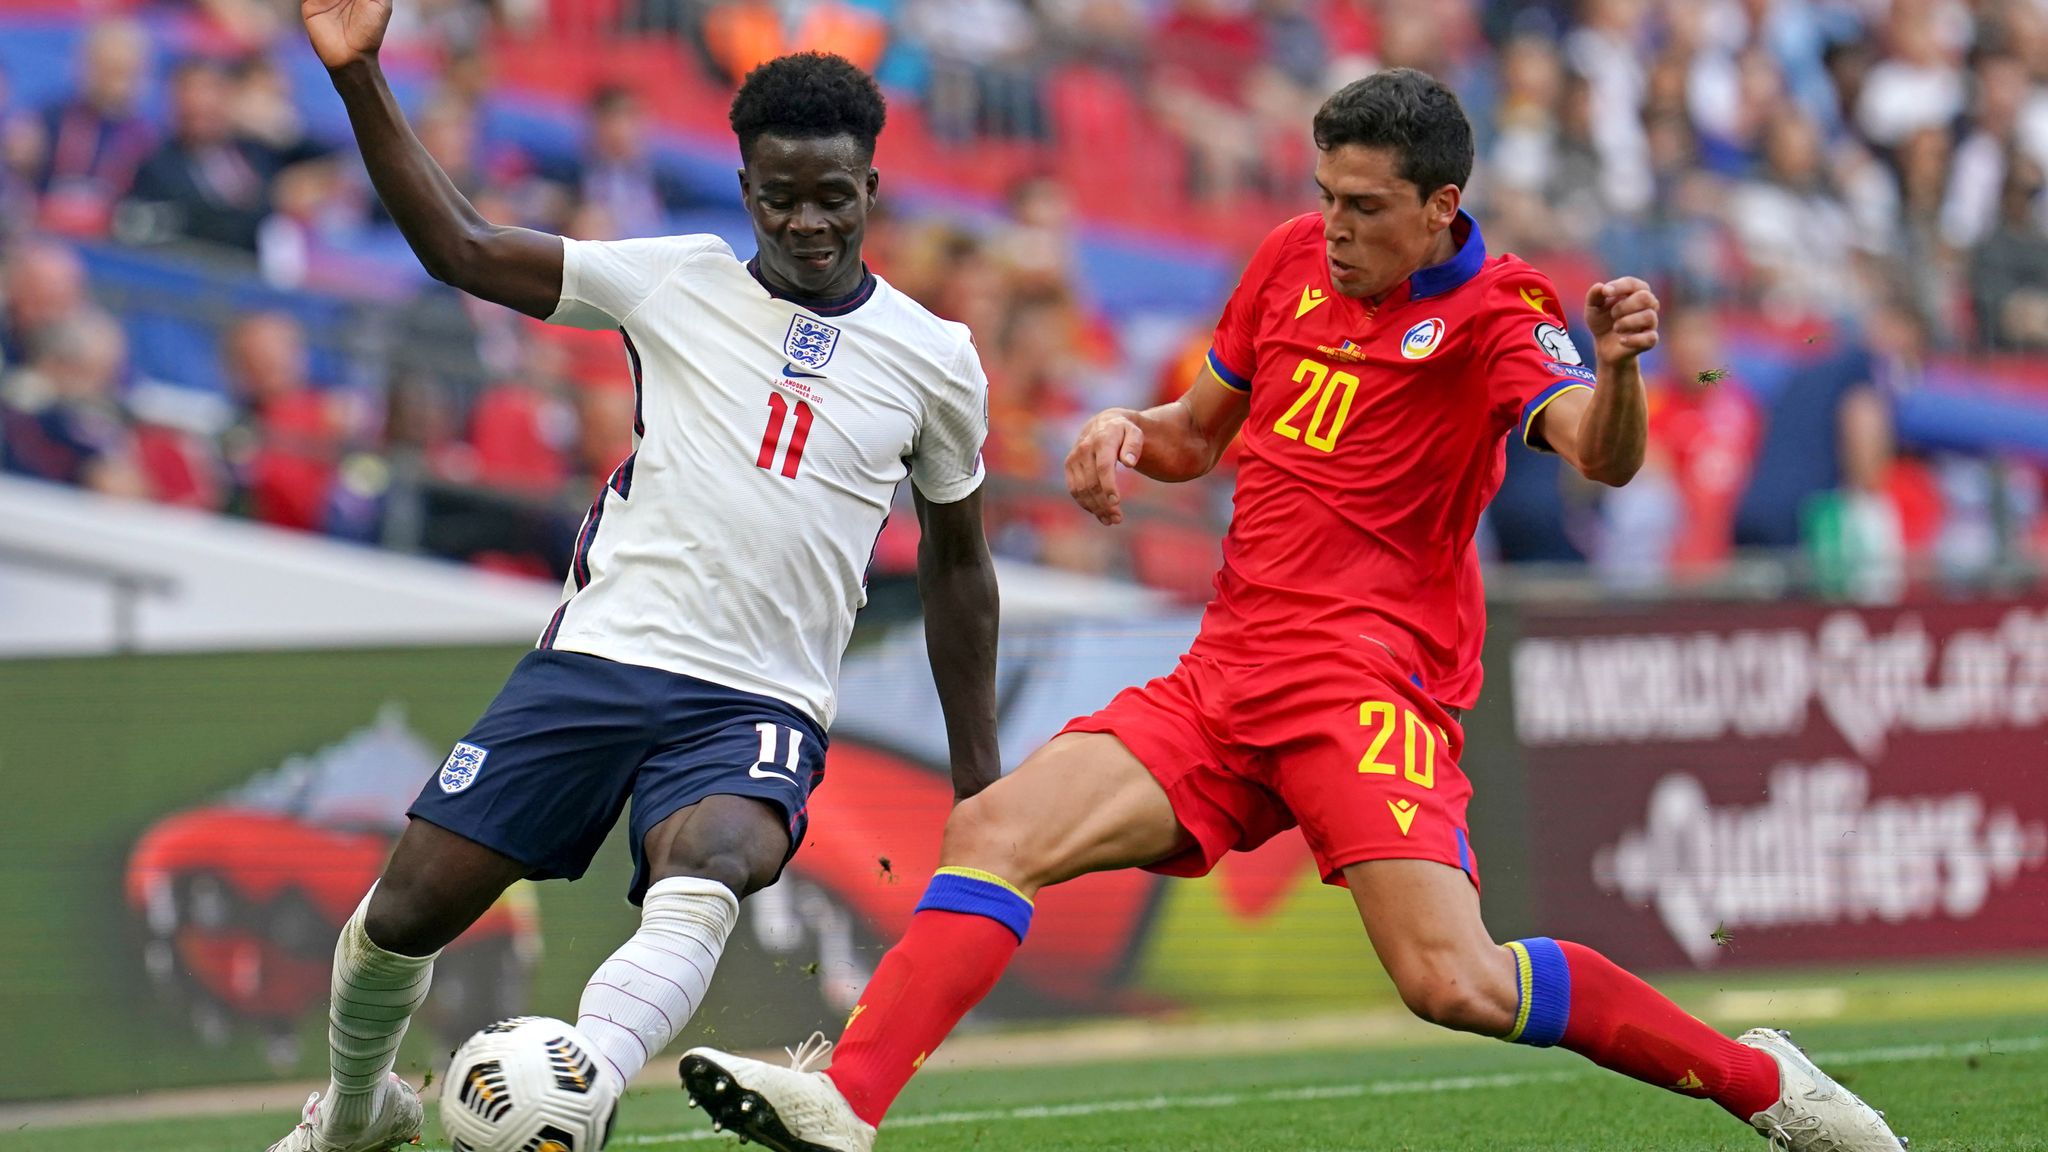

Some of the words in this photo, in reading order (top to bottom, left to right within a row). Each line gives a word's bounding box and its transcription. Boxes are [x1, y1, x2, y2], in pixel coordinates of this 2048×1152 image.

[1411, 334, 1432, 344] FAF
[1565, 368, 1597, 382] RESP
[784, 379, 811, 393] ANDORRA
[1273, 358, 1360, 453] 20
[756, 391, 814, 480] 11
[1730, 628, 1808, 736] CUP
[755, 722, 804, 773] 11
[1358, 701, 1435, 789] 20
[1648, 758, 1992, 968] Qualifiers
